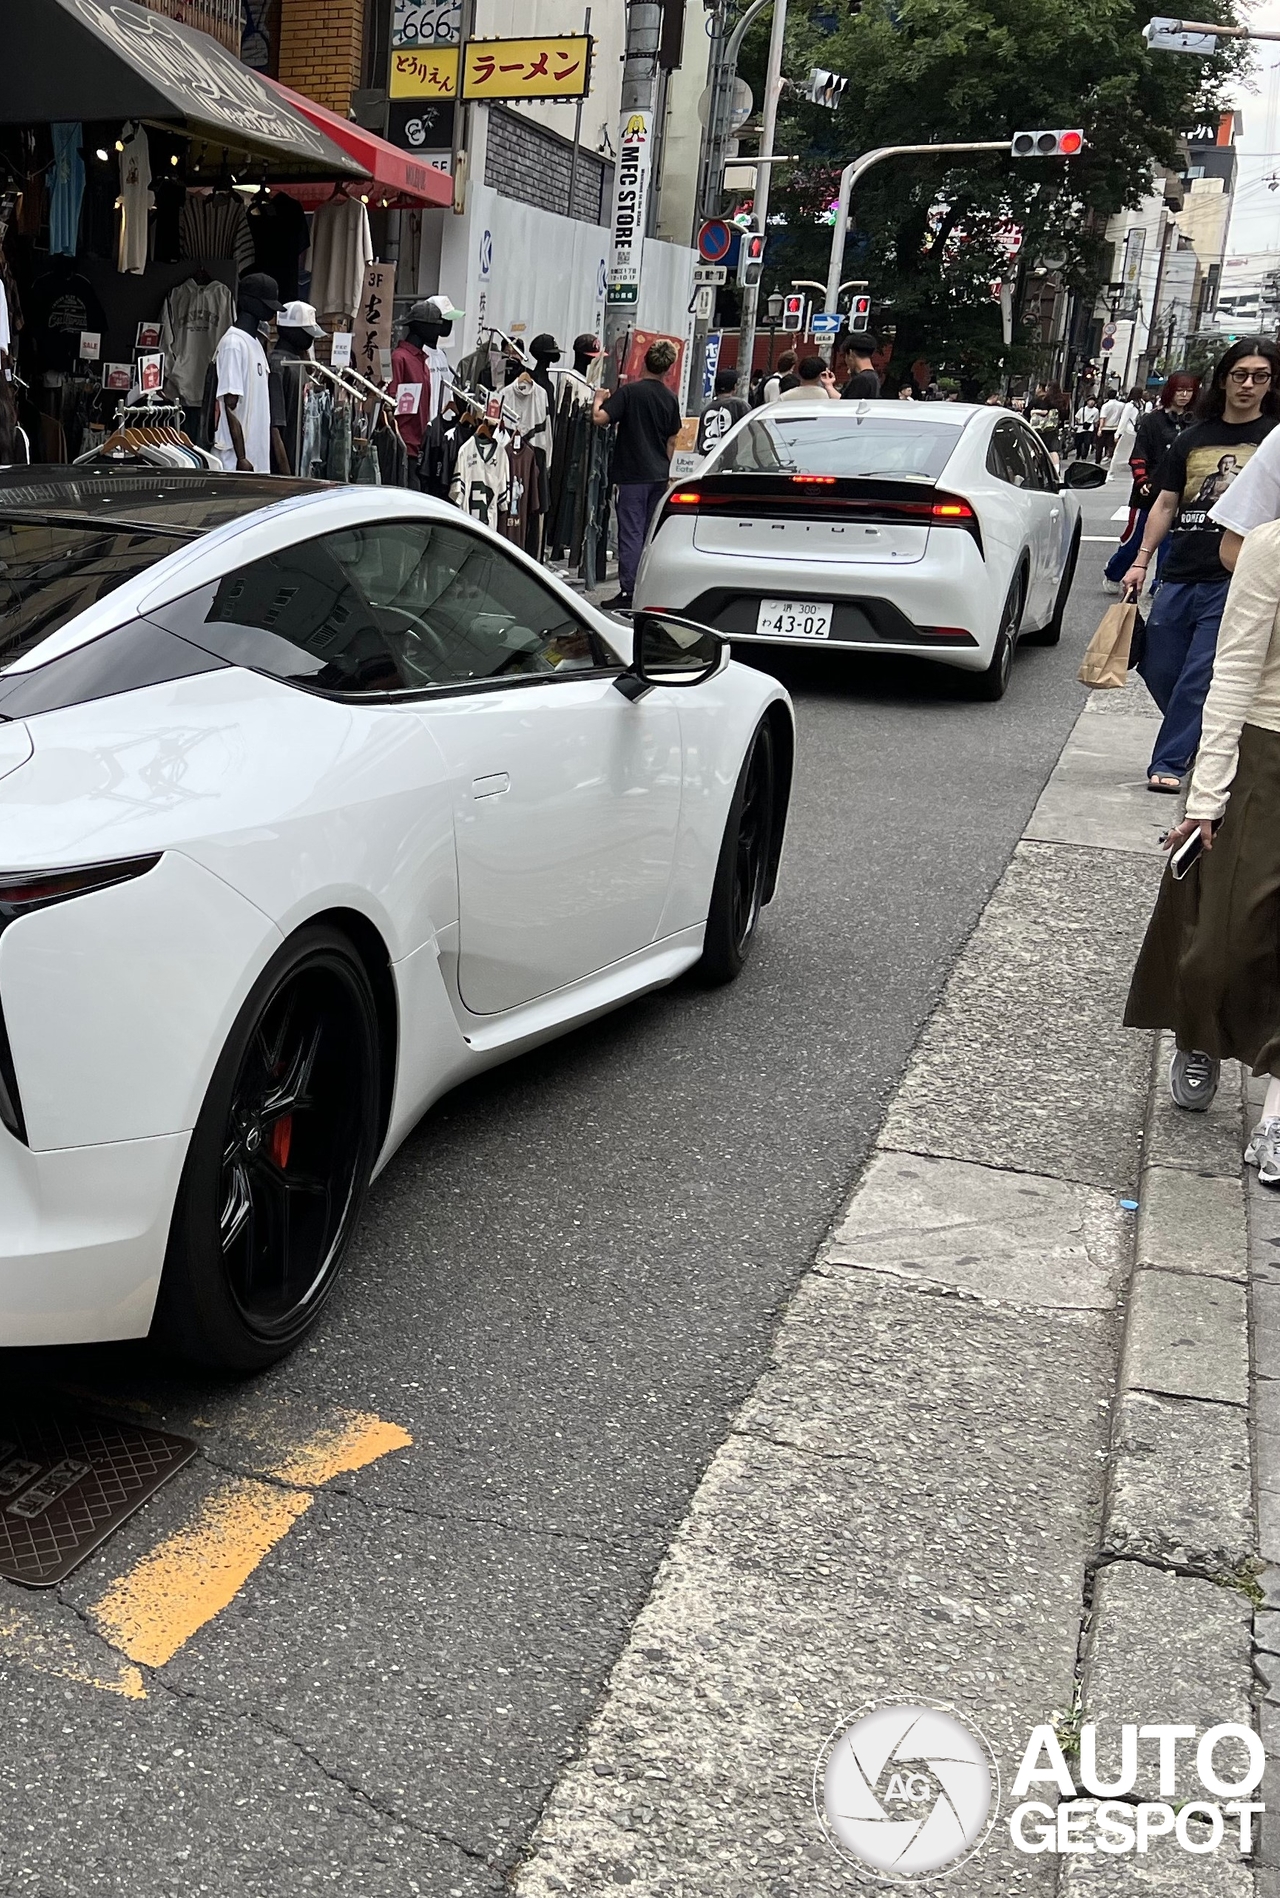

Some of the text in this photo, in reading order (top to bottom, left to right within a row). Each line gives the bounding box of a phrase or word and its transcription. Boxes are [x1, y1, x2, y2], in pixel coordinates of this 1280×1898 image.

[402, 9, 452, 39] 666
[395, 54, 454, 93] とうりえん
[471, 52, 580, 85] ラーメン
[614, 146, 640, 250] MFC STORE
[368, 272, 384, 288] 3F
[82, 341, 98, 350] SALE
[675, 464, 694, 474] Eats
[676, 457, 695, 467] Uber
[1181, 513, 1206, 524] ROMEO
[798, 604, 817, 615] 300
[761, 615, 827, 636] わ 43-02
